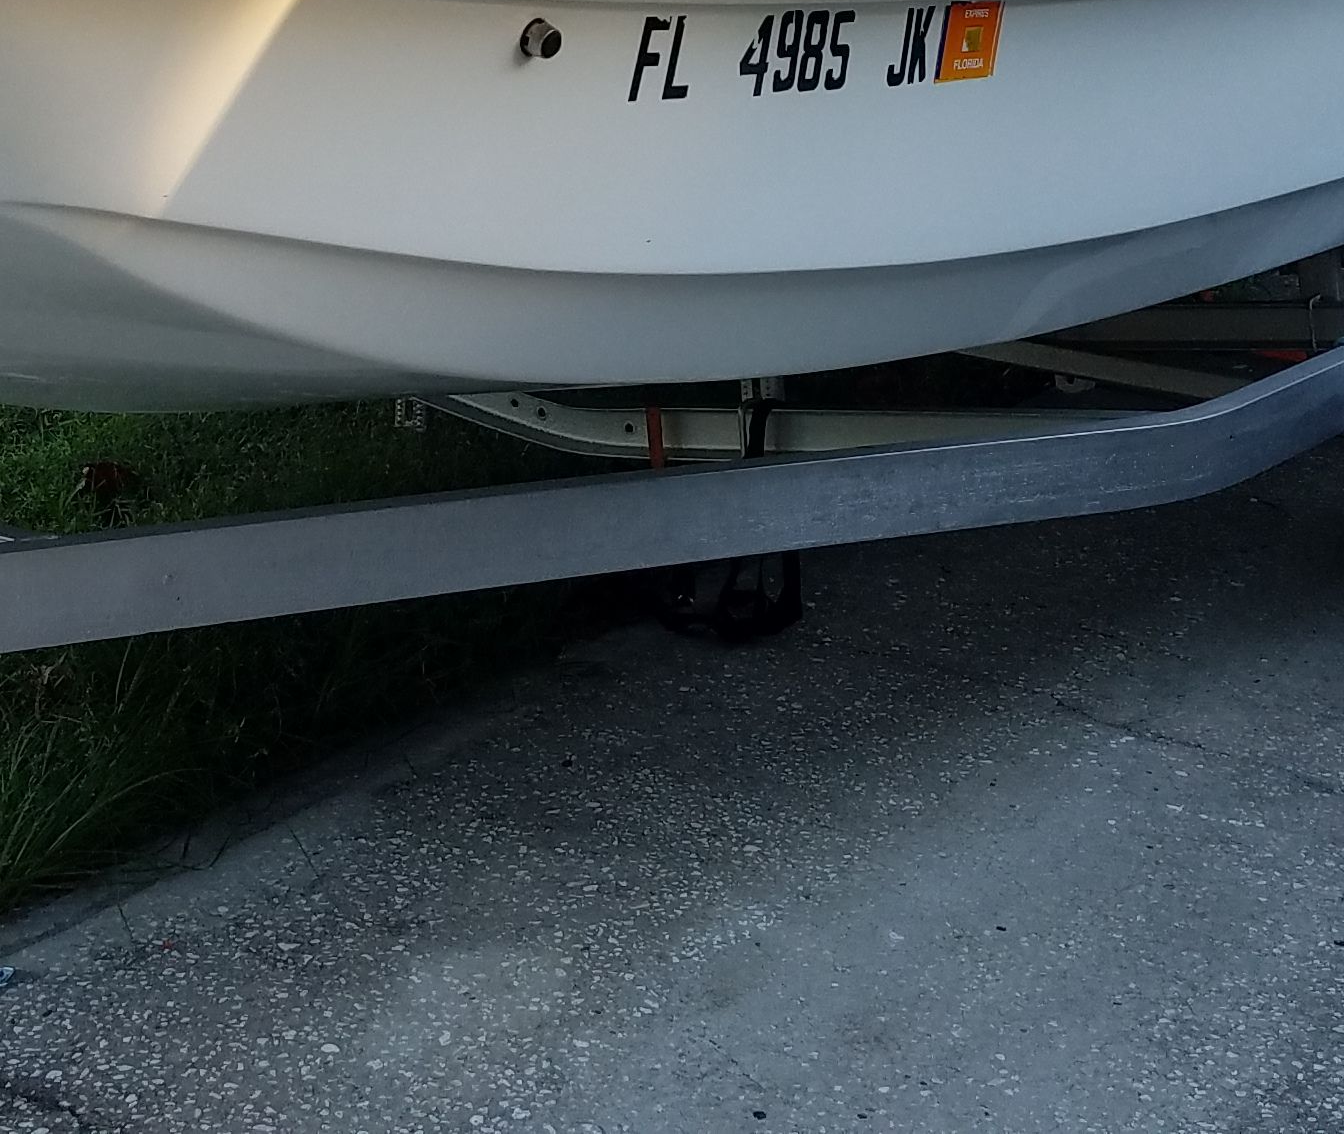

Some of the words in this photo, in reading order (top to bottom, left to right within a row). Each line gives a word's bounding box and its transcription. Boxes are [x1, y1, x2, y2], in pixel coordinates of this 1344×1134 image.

[627, 14, 690, 103] FL
[737, 9, 856, 98] 4985
[886, 4, 937, 88] JK
[953, 57, 984, 71] FLORIDA
